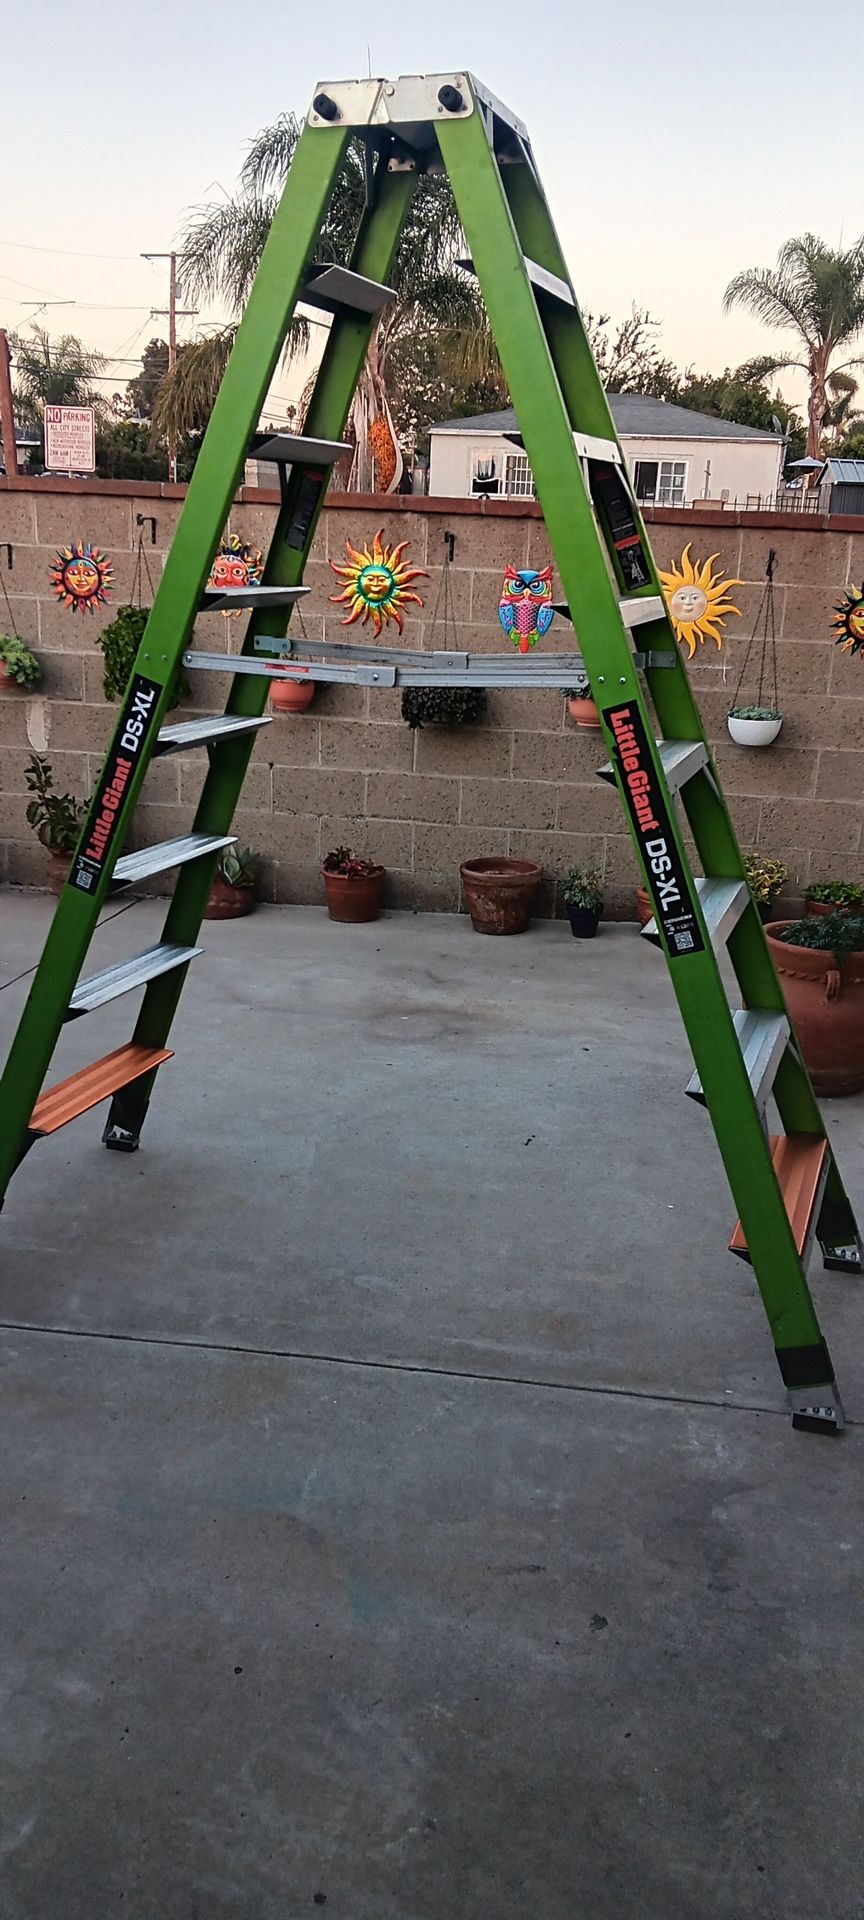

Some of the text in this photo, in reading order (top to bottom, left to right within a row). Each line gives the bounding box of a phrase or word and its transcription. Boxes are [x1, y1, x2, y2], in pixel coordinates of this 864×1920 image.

[47, 408, 90, 423] NO PARKING
[120, 687, 156, 753] DS-XL
[645, 838, 681, 912] DS-XL
